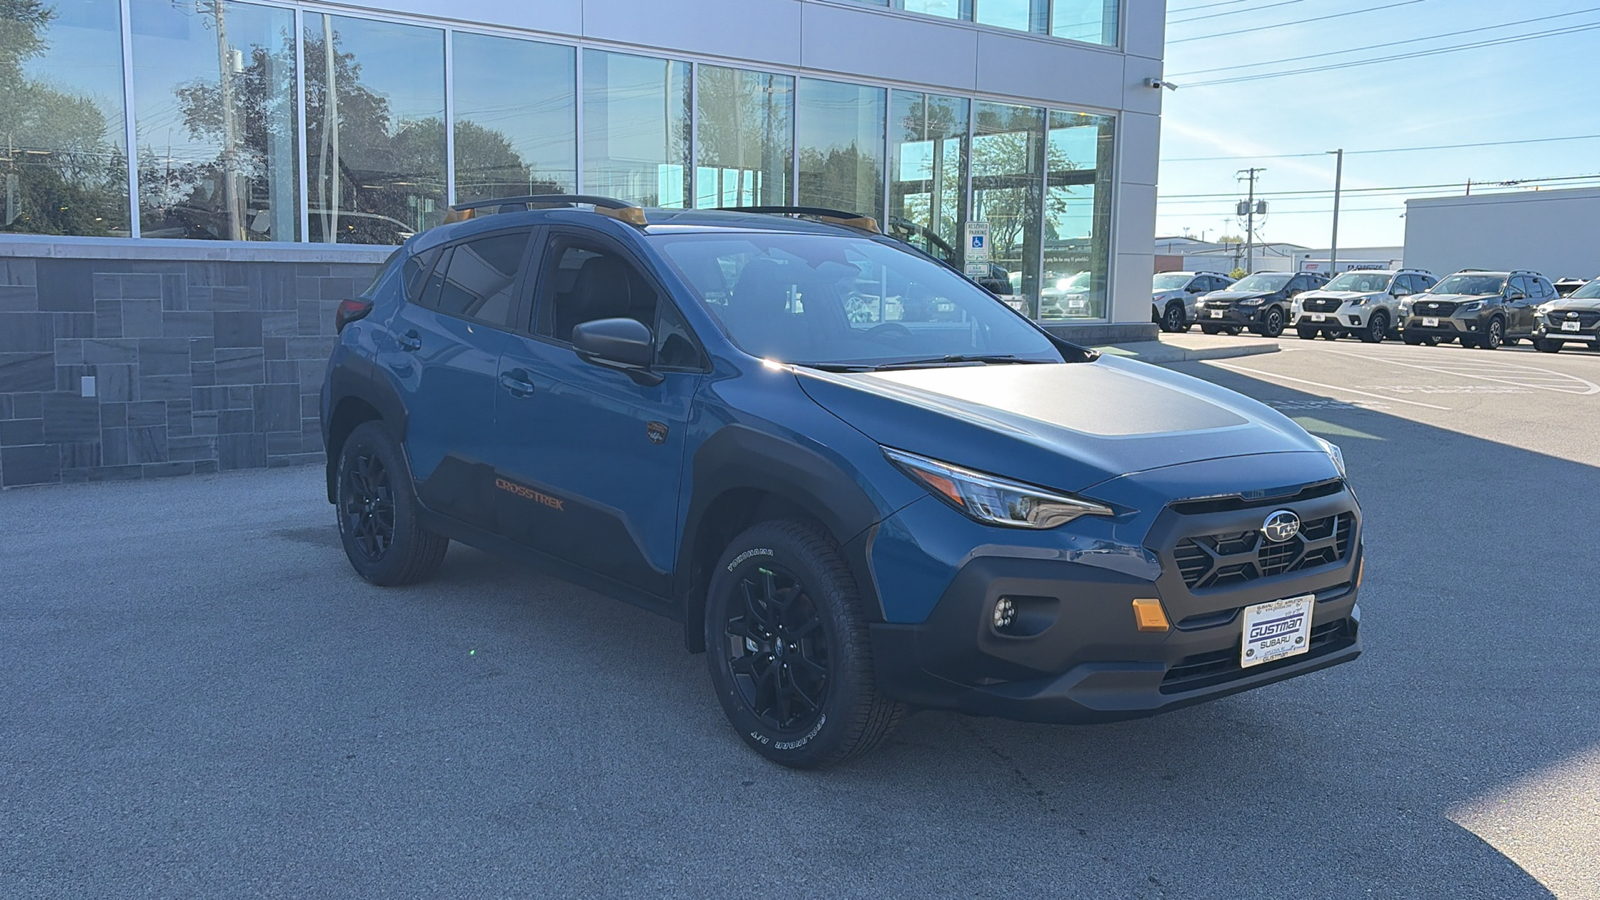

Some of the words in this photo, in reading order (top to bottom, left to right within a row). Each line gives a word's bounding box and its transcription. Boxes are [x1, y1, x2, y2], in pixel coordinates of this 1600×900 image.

[495, 478, 564, 511] CROSSTREK
[727, 548, 774, 572] YOKOHAMA
[1260, 635, 1291, 649] SUBARU
[750, 731, 770, 745] A/T
